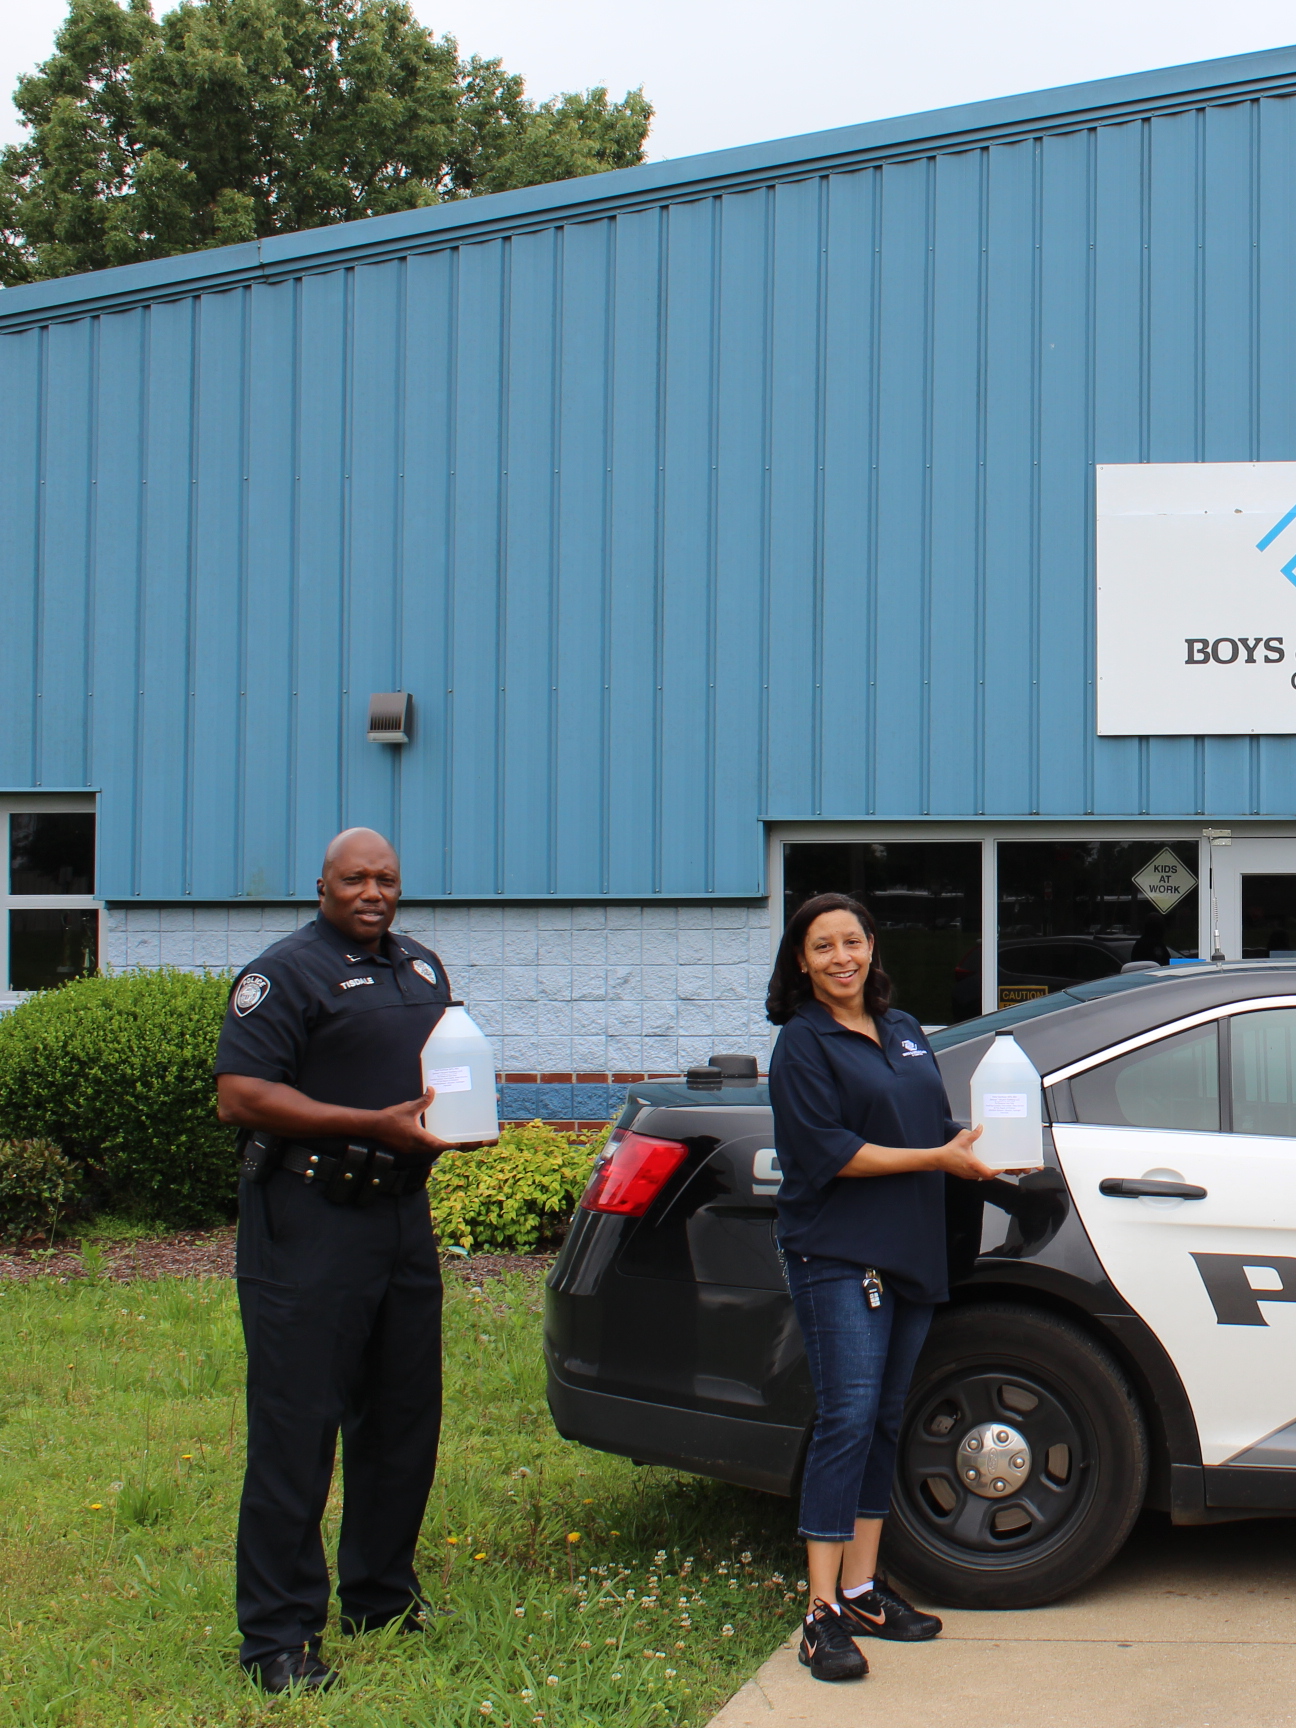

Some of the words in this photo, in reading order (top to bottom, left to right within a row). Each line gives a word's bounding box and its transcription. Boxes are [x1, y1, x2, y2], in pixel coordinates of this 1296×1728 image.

[1184, 637, 1285, 664] BOYS
[1153, 864, 1178, 874] KIDS
[1158, 875, 1172, 884] AT
[1149, 885, 1181, 894] WORK
[243, 976, 267, 988] POLICE
[339, 976, 375, 990] TISDALE
[1002, 991, 1044, 1000] CAUTION
